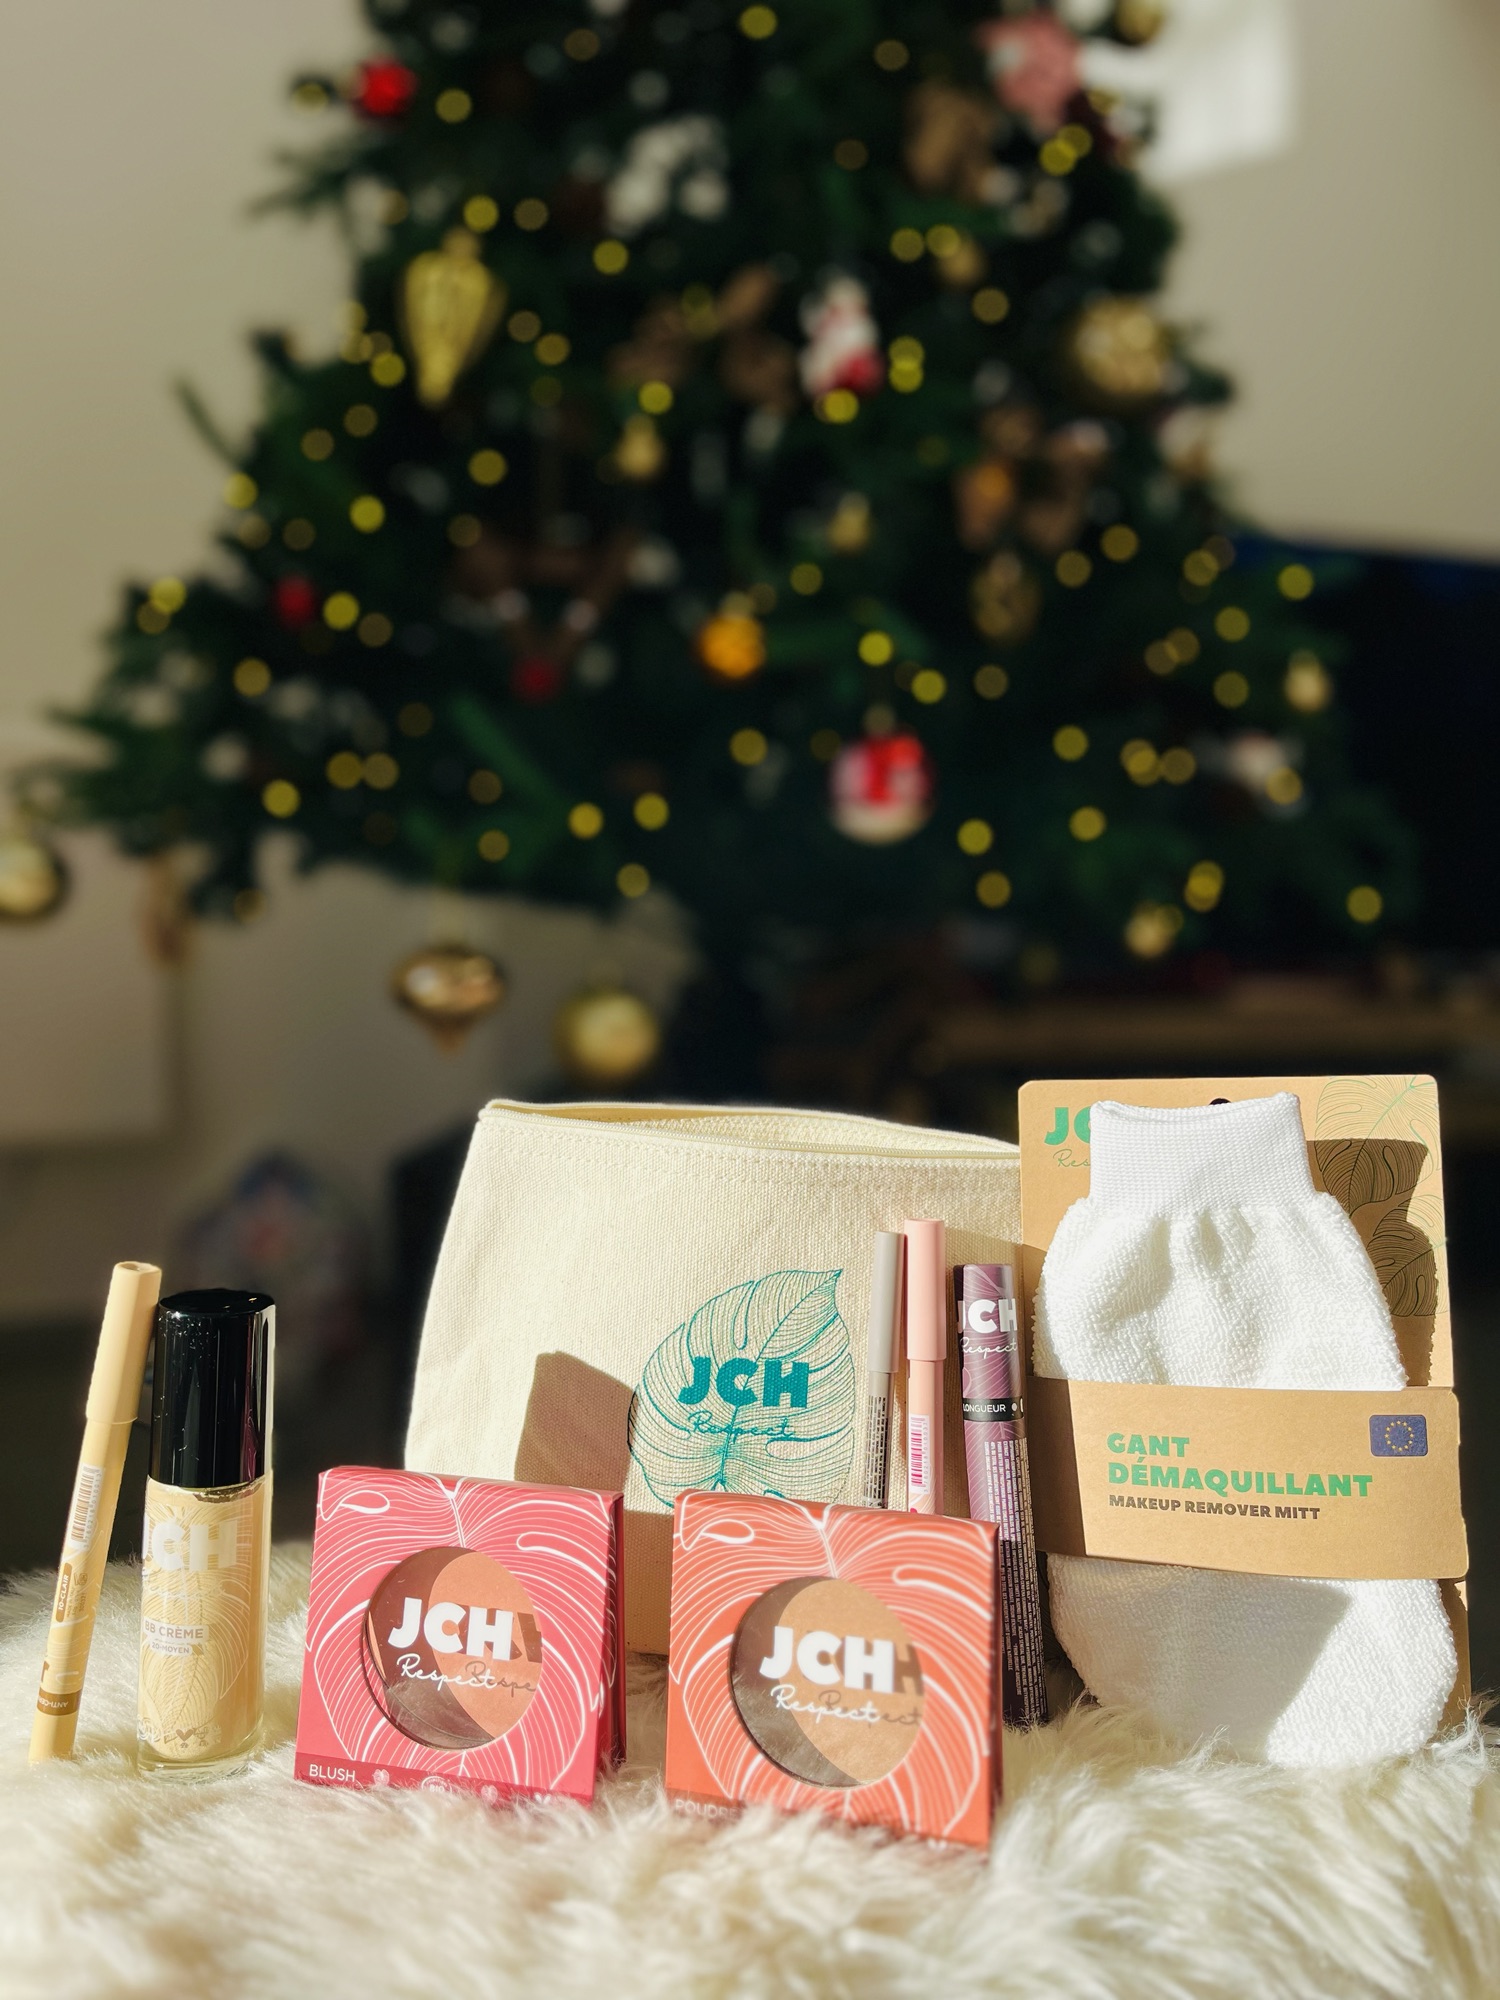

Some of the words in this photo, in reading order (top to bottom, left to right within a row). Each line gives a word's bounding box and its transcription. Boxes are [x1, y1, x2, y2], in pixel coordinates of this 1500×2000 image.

[1044, 1106, 1091, 1145] JC
[678, 1356, 809, 1408] JCH
[688, 1410, 795, 1444] Respect
[1107, 1433, 1190, 1457] GANT
[1108, 1457, 1373, 1497] DÉMAQUILLANT
[1109, 1494, 1181, 1512] MAKEUP
[1185, 1500, 1272, 1518] REMOVER
[1274, 1505, 1320, 1520] MITT
[145, 1620, 156, 1633] BB
[159, 1626, 204, 1639] CRÈME
[151, 1641, 190, 1654] 20-MOYEN
[387, 1597, 514, 1661] JCH
[397, 1653, 498, 1691] Respect
[759, 1626, 894, 1694] JCH
[770, 1684, 881, 1723] Respect
[309, 1764, 356, 1782] BLUSH
